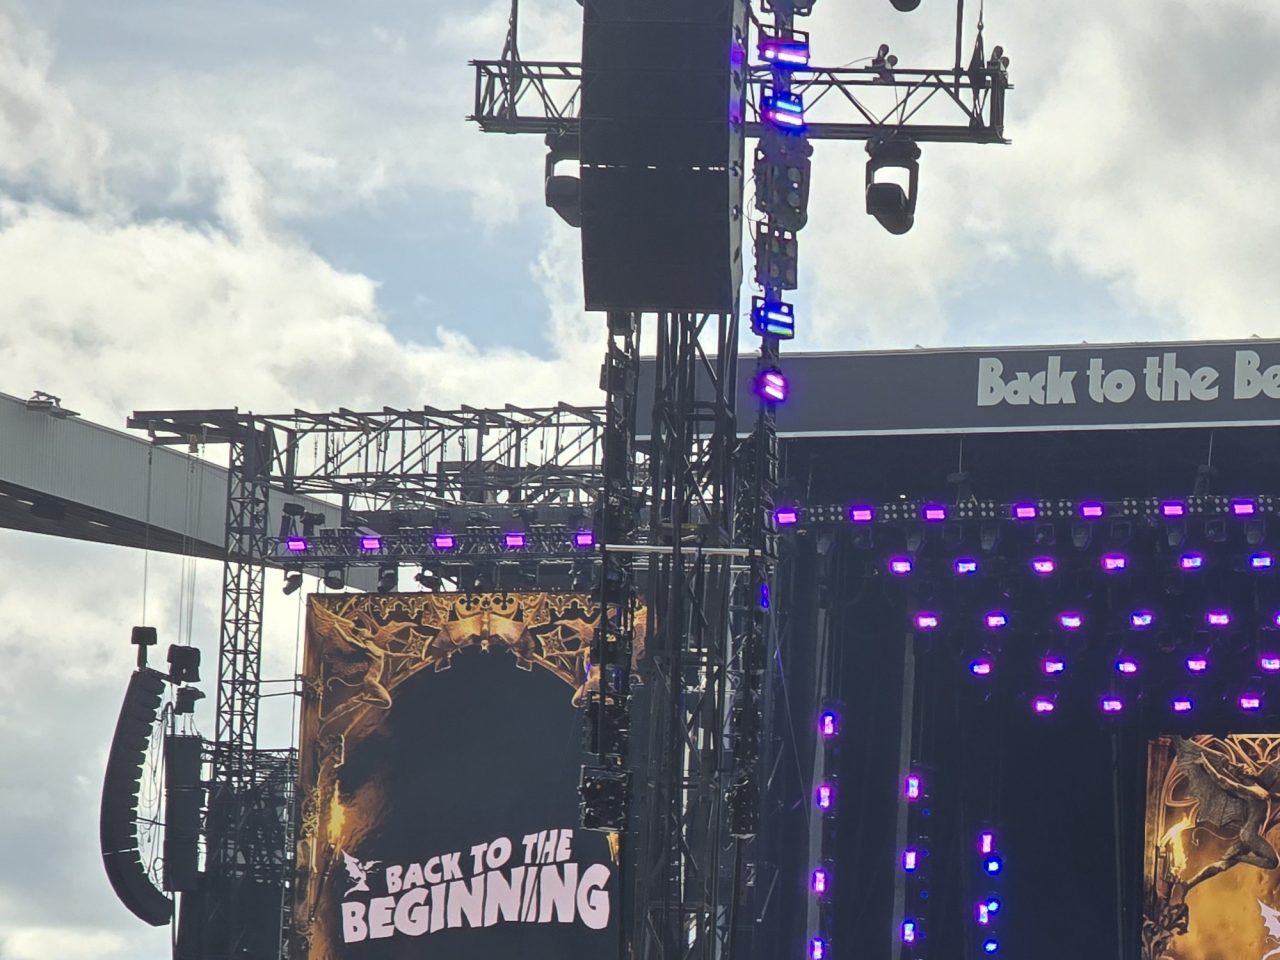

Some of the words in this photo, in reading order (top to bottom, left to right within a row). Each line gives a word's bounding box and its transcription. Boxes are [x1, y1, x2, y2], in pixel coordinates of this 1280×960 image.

[977, 356, 1077, 406] Back
[1087, 358, 1136, 403] to
[1143, 353, 1219, 401] the
[386, 852, 463, 894] BACK
[470, 837, 512, 875] TO
[522, 828, 574, 864] THE
[341, 863, 611, 943] BEGINNING
